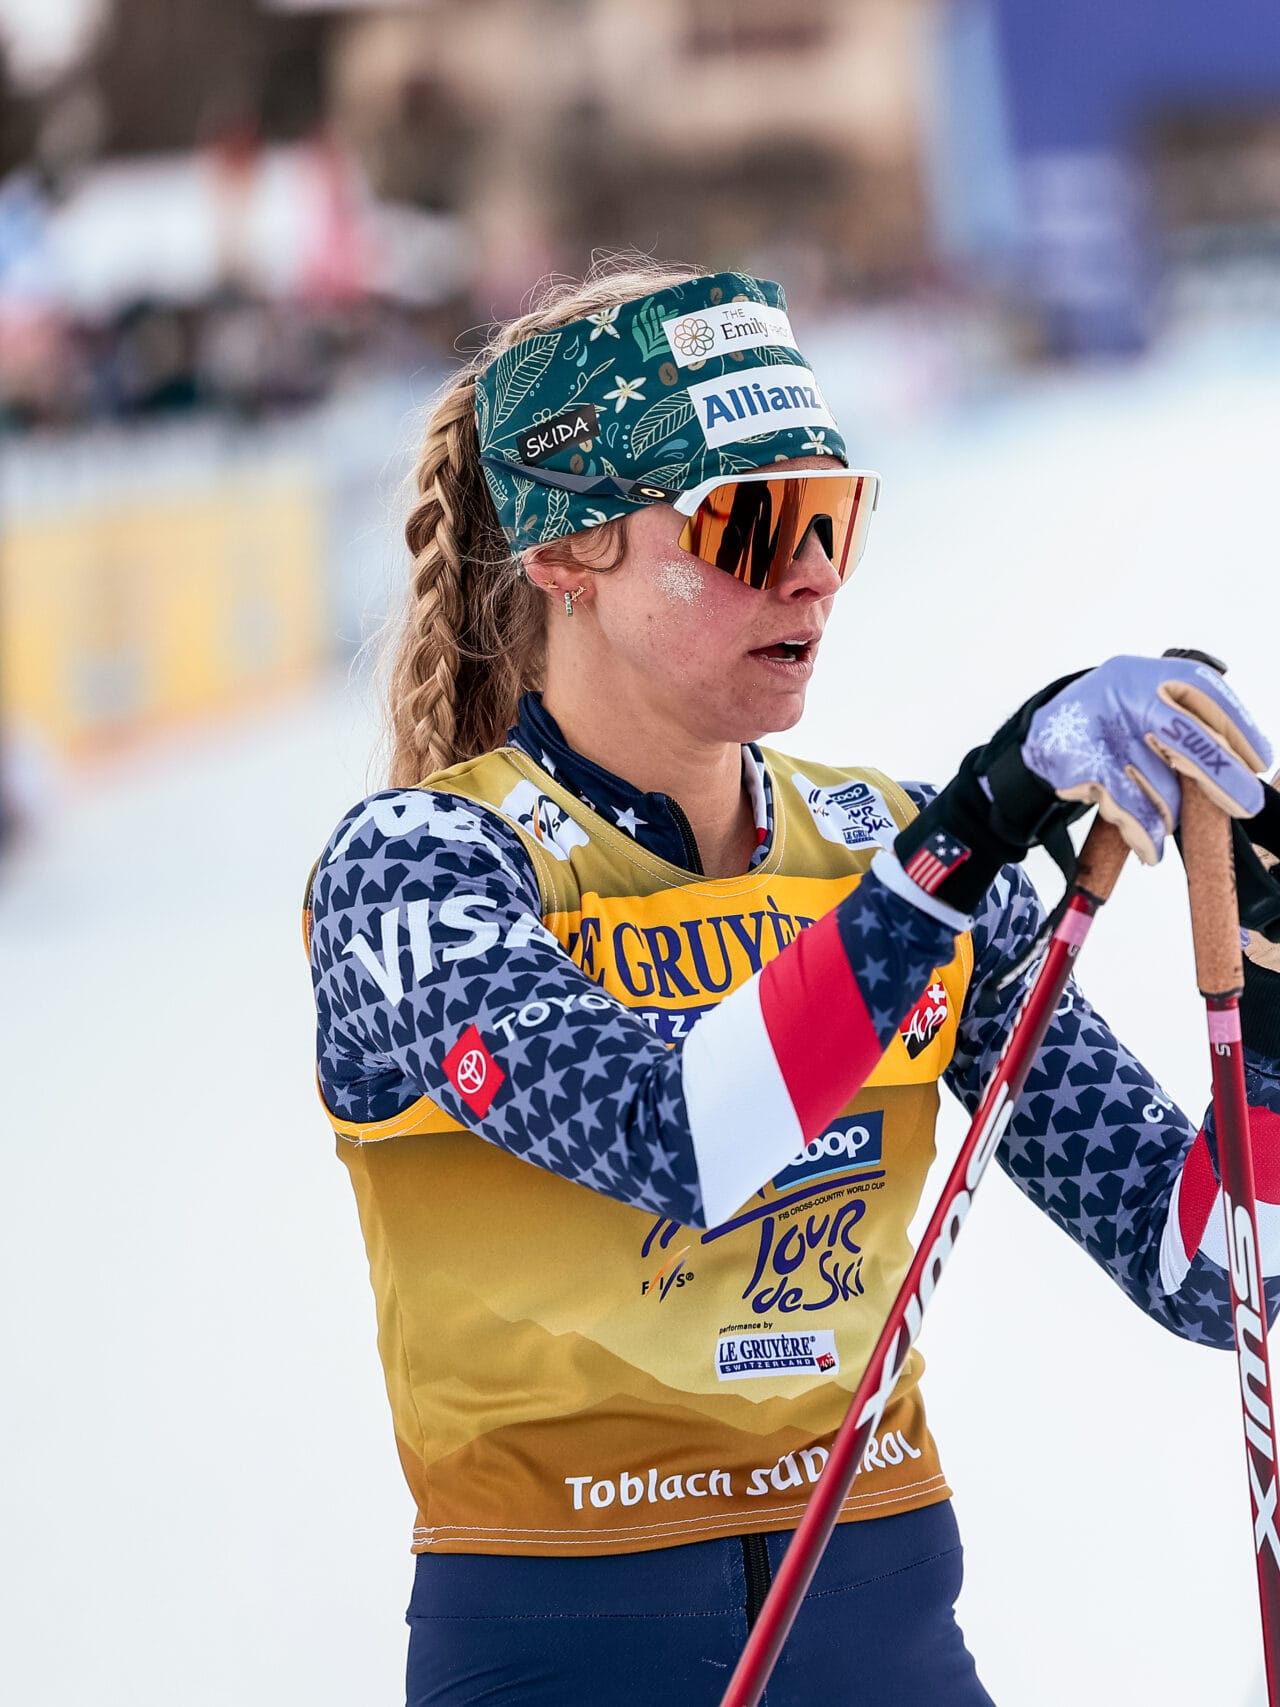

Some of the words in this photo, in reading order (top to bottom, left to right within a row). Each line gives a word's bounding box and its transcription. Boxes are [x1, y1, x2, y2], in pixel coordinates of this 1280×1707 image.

[720, 317, 769, 341] Emily
[722, 308, 746, 320] THE
[702, 382, 822, 429] Allianz
[526, 416, 590, 458] SKIDA
[1160, 716, 1231, 776] SWIX
[341, 894, 570, 1008] VISA
[778, 1210, 790, 1222] FIS
[790, 1190, 844, 1216] CROSS-COUNTRY
[846, 1183, 870, 1195] WORLD
[871, 1181, 886, 1191] CUP
[752, 1276, 803, 1314] de
[718, 1321, 762, 1335] performance
[763, 1321, 773, 1331] by
[719, 1341, 738, 1363] LE
[724, 1359, 812, 1373] SWITZERLAND
[565, 1469, 733, 1510] Toblach
